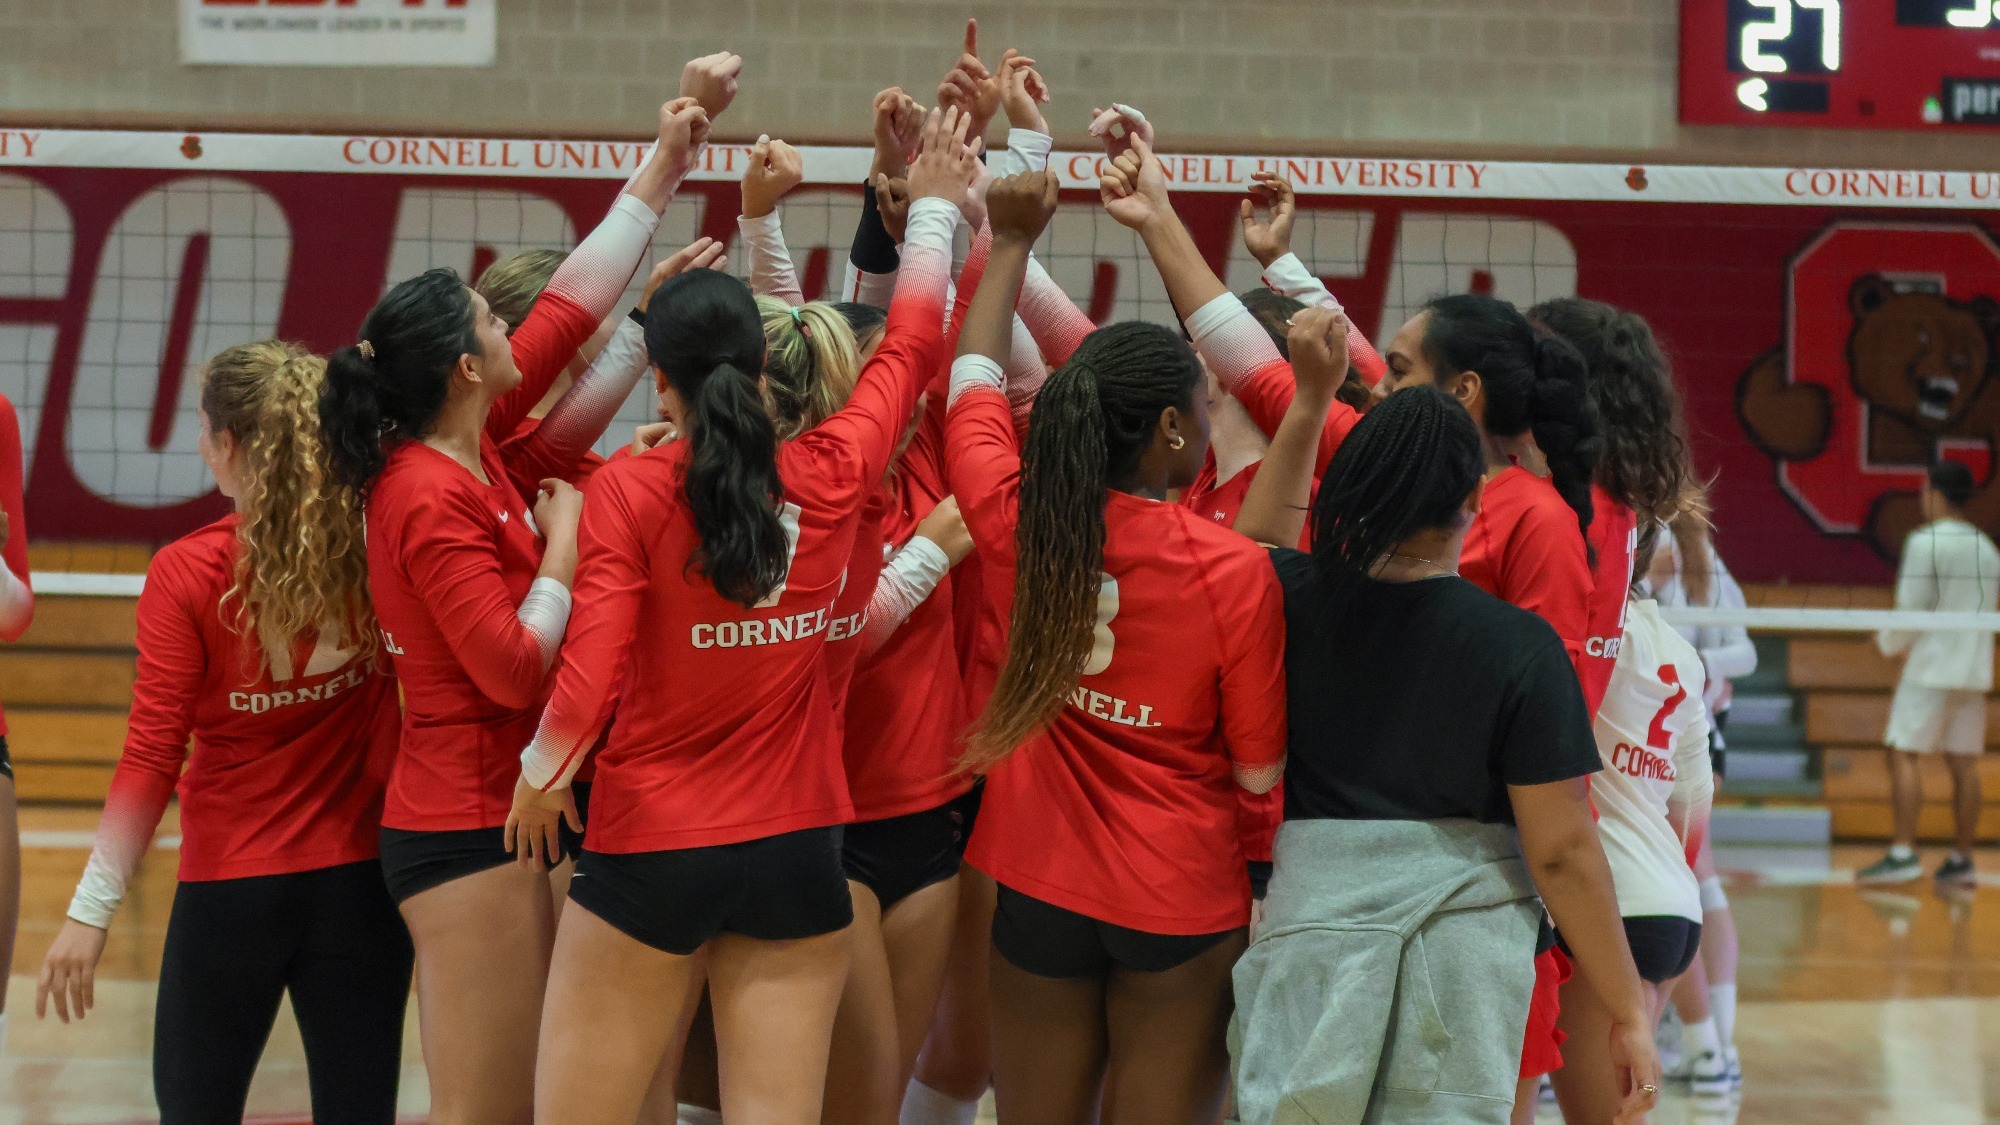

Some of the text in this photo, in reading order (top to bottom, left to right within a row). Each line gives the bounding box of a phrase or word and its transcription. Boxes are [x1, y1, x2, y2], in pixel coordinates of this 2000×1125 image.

[342, 138, 519, 168] CORNELL
[1068, 155, 1243, 184] CNELL
[1785, 171, 1956, 199] CORNELL
[690, 600, 836, 649] CORNEL
[1646, 663, 1687, 750] 2
